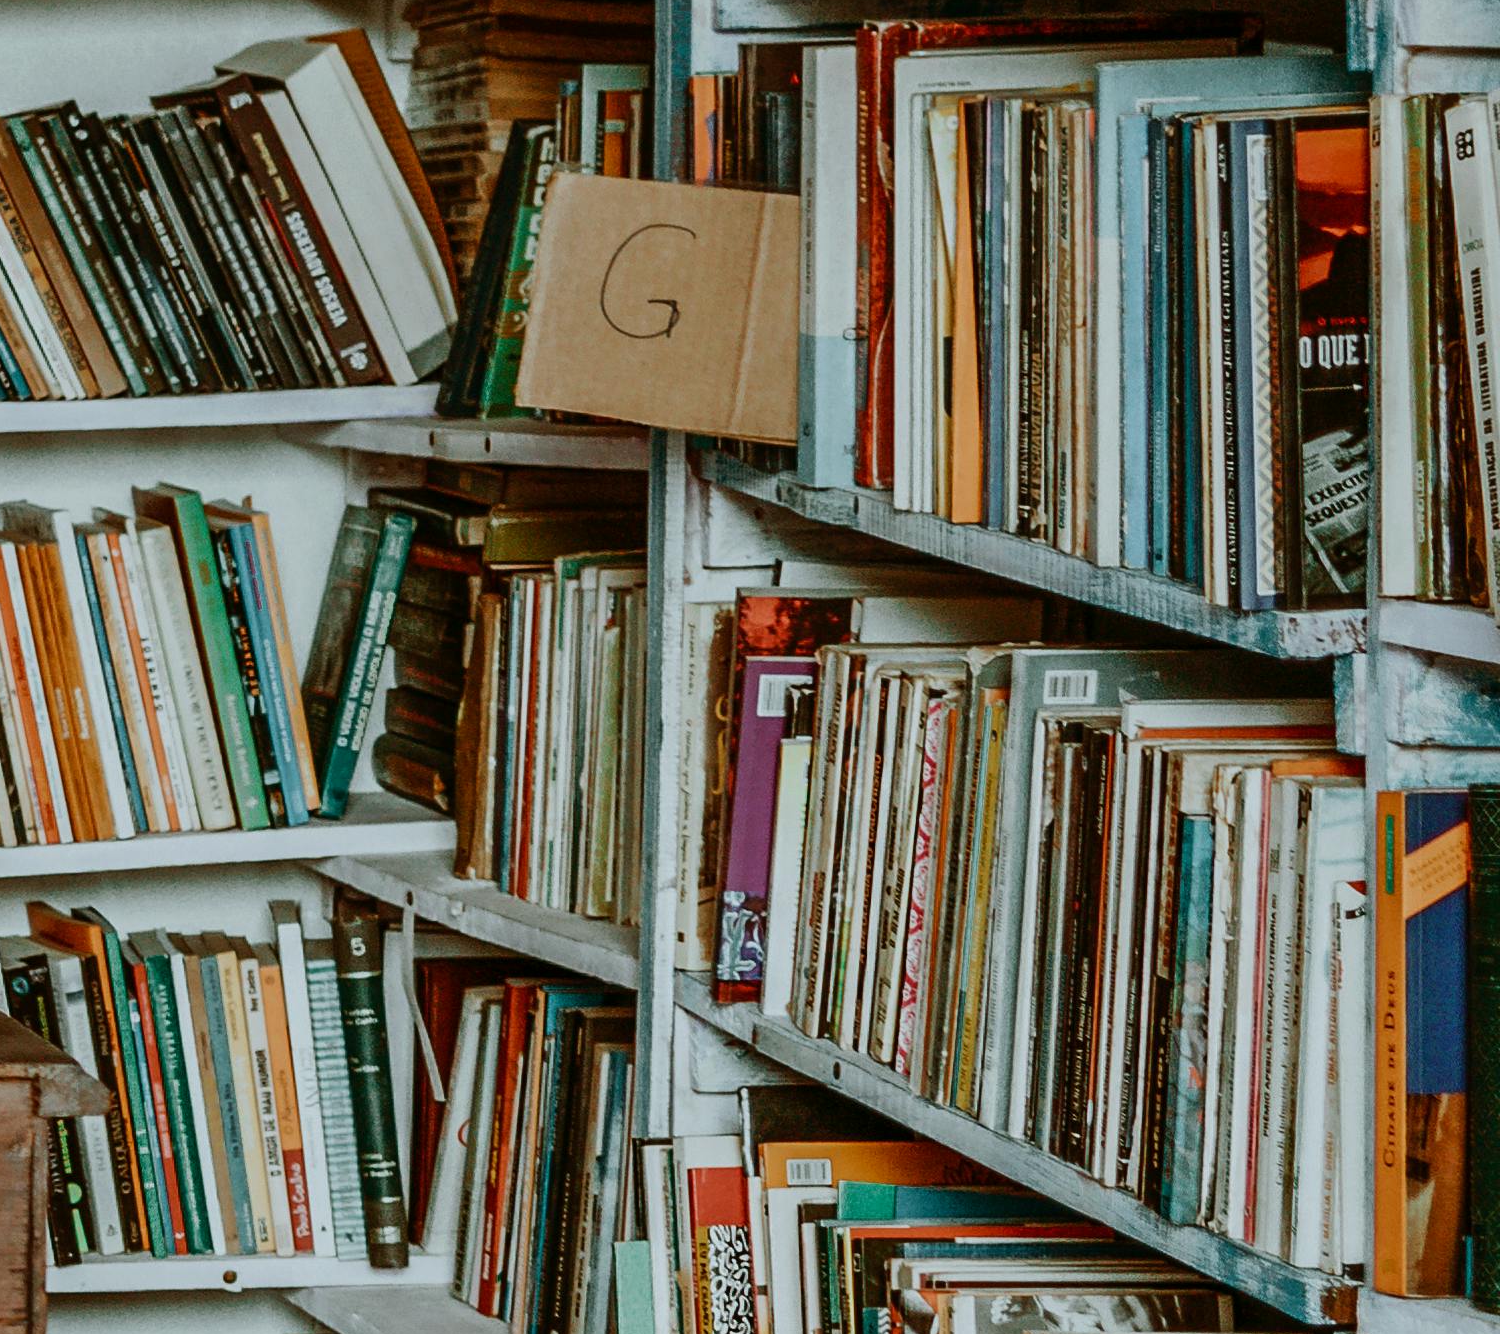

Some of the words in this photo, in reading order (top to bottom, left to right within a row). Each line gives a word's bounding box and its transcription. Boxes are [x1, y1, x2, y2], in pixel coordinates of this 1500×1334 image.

[600, 222, 699, 341] G
[1471, 266, 1488, 336] BRASILEIRA
[1298, 335, 1311, 369] O
[1318, 333, 1359, 368] QUE
[1476, 339, 1493, 414] LITERATURA
[1224, 380, 1237, 481] SILENCIOSOS
[1225, 483, 1238, 565] TAMBORES
[340, 699, 358, 736] VERDE
[337, 736, 348, 747] O
[350, 936, 367, 957] 5
[1382, 969, 1397, 1034] DEUS
[260, 1048, 273, 1087] HUMOR
[1384, 1046, 1397, 1070] DE
[1381, 1078, 1397, 1169] CIDADE
[293, 1163, 311, 1204] Coelho
[296, 1206, 313, 1239] Paulo
